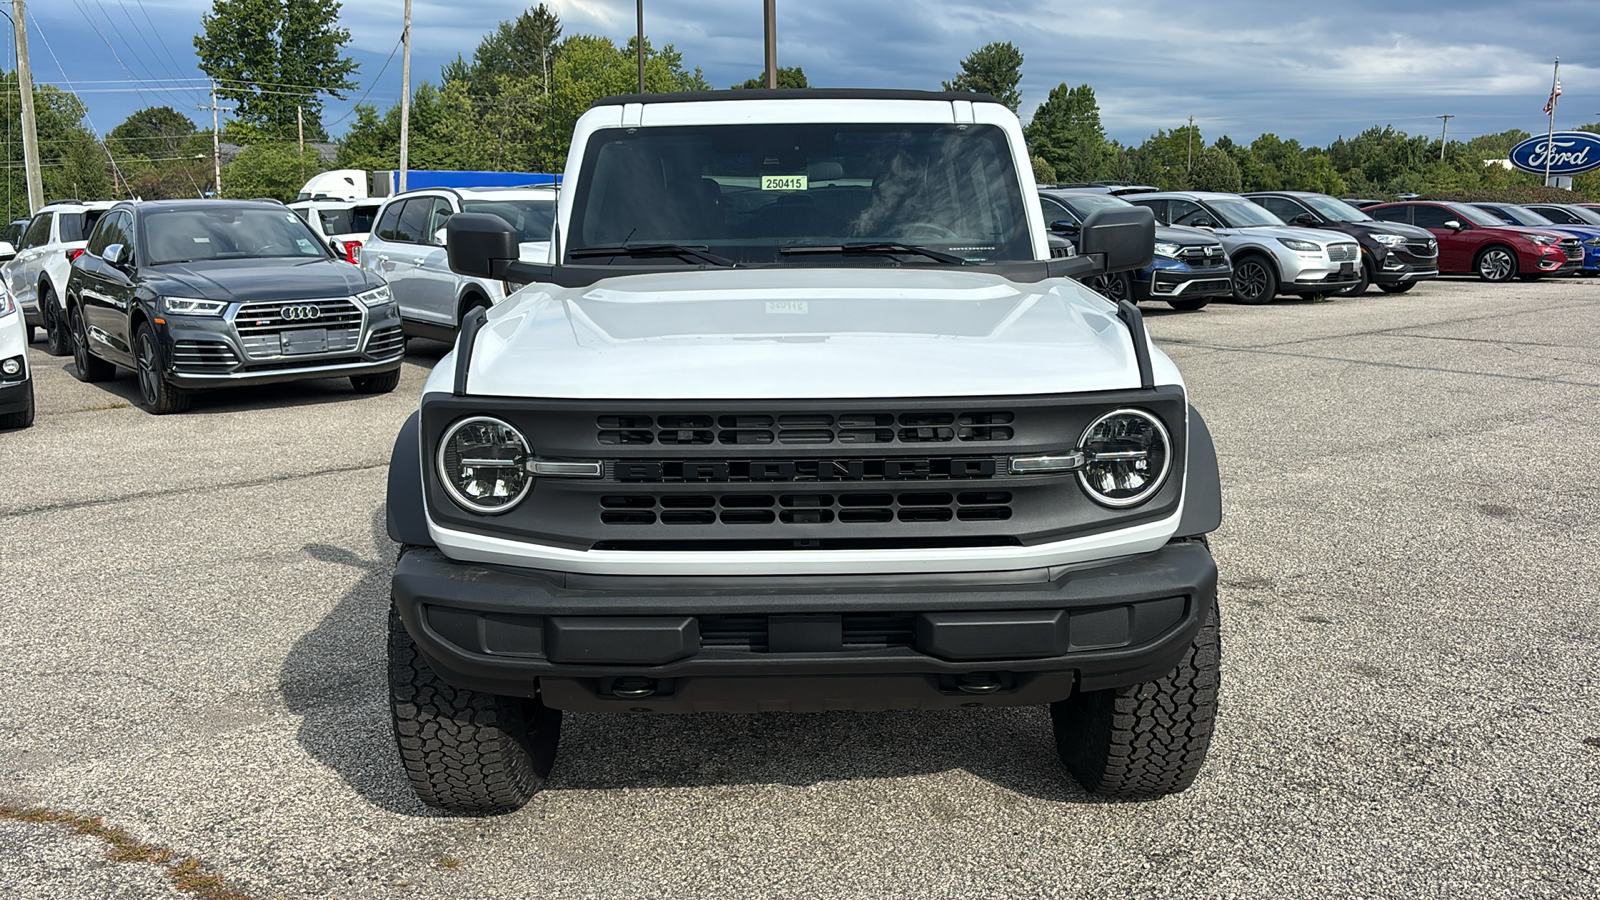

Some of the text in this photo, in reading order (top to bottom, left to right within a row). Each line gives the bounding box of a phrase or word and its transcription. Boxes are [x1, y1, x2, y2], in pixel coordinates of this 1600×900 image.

[1528, 141, 1591, 166] Ford
[766, 178, 802, 189] 250415
[614, 459, 996, 480] BRONCO
